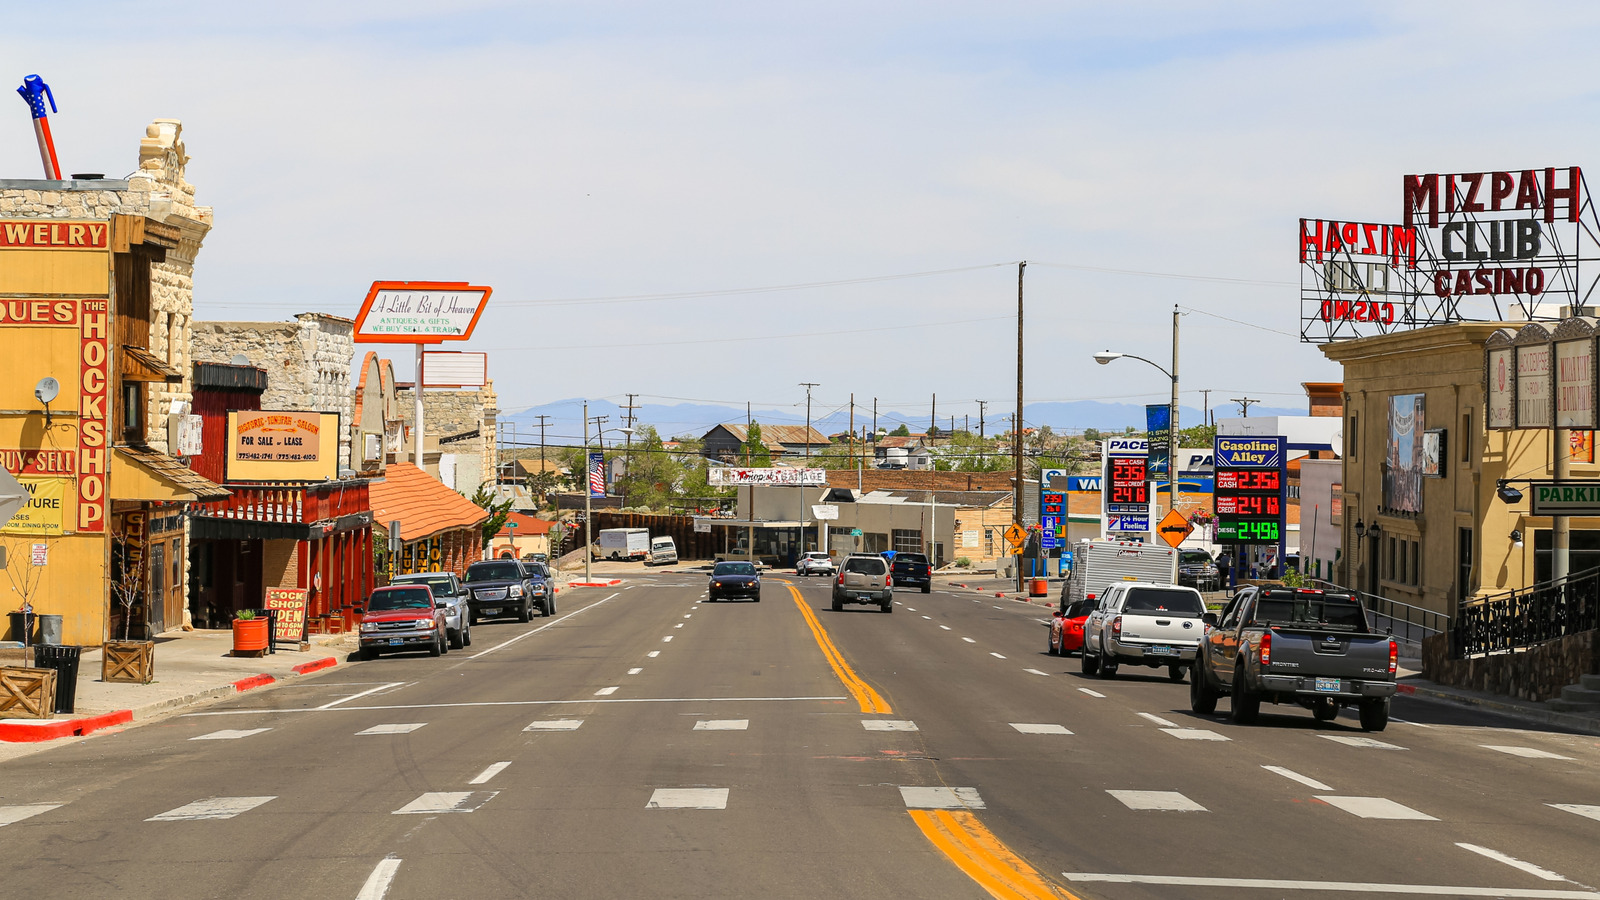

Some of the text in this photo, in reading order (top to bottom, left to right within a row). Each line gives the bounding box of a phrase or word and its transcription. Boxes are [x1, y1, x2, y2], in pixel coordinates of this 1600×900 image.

[1404, 166, 1580, 229] MIZPAH
[0, 224, 104, 245] WELRY
[1442, 219, 1541, 260] CLUB
[1434, 267, 1545, 298] CASINO
[84, 302, 106, 311] THE
[371, 295, 475, 317] A Little Bit of Heaven
[380, 317, 418, 325] ANTIQUES
[241, 436, 254, 446] FOR
[258, 436, 274, 446] SALE
[283, 437, 303, 446] LEASE
[1109, 440, 1149, 449] PACE
[1220, 441, 1277, 451] Gasoline
[36, 451, 72, 472] SELL
[1231, 452, 1266, 464] Alley
[1123, 522, 1147, 530] Fueling
[417, 540, 428, 573] AINT
[270, 591, 303, 600] HOCK
[269, 600, 303, 608] SHOP
[275, 610, 303, 622] PEN
[287, 629, 301, 637] DAY
